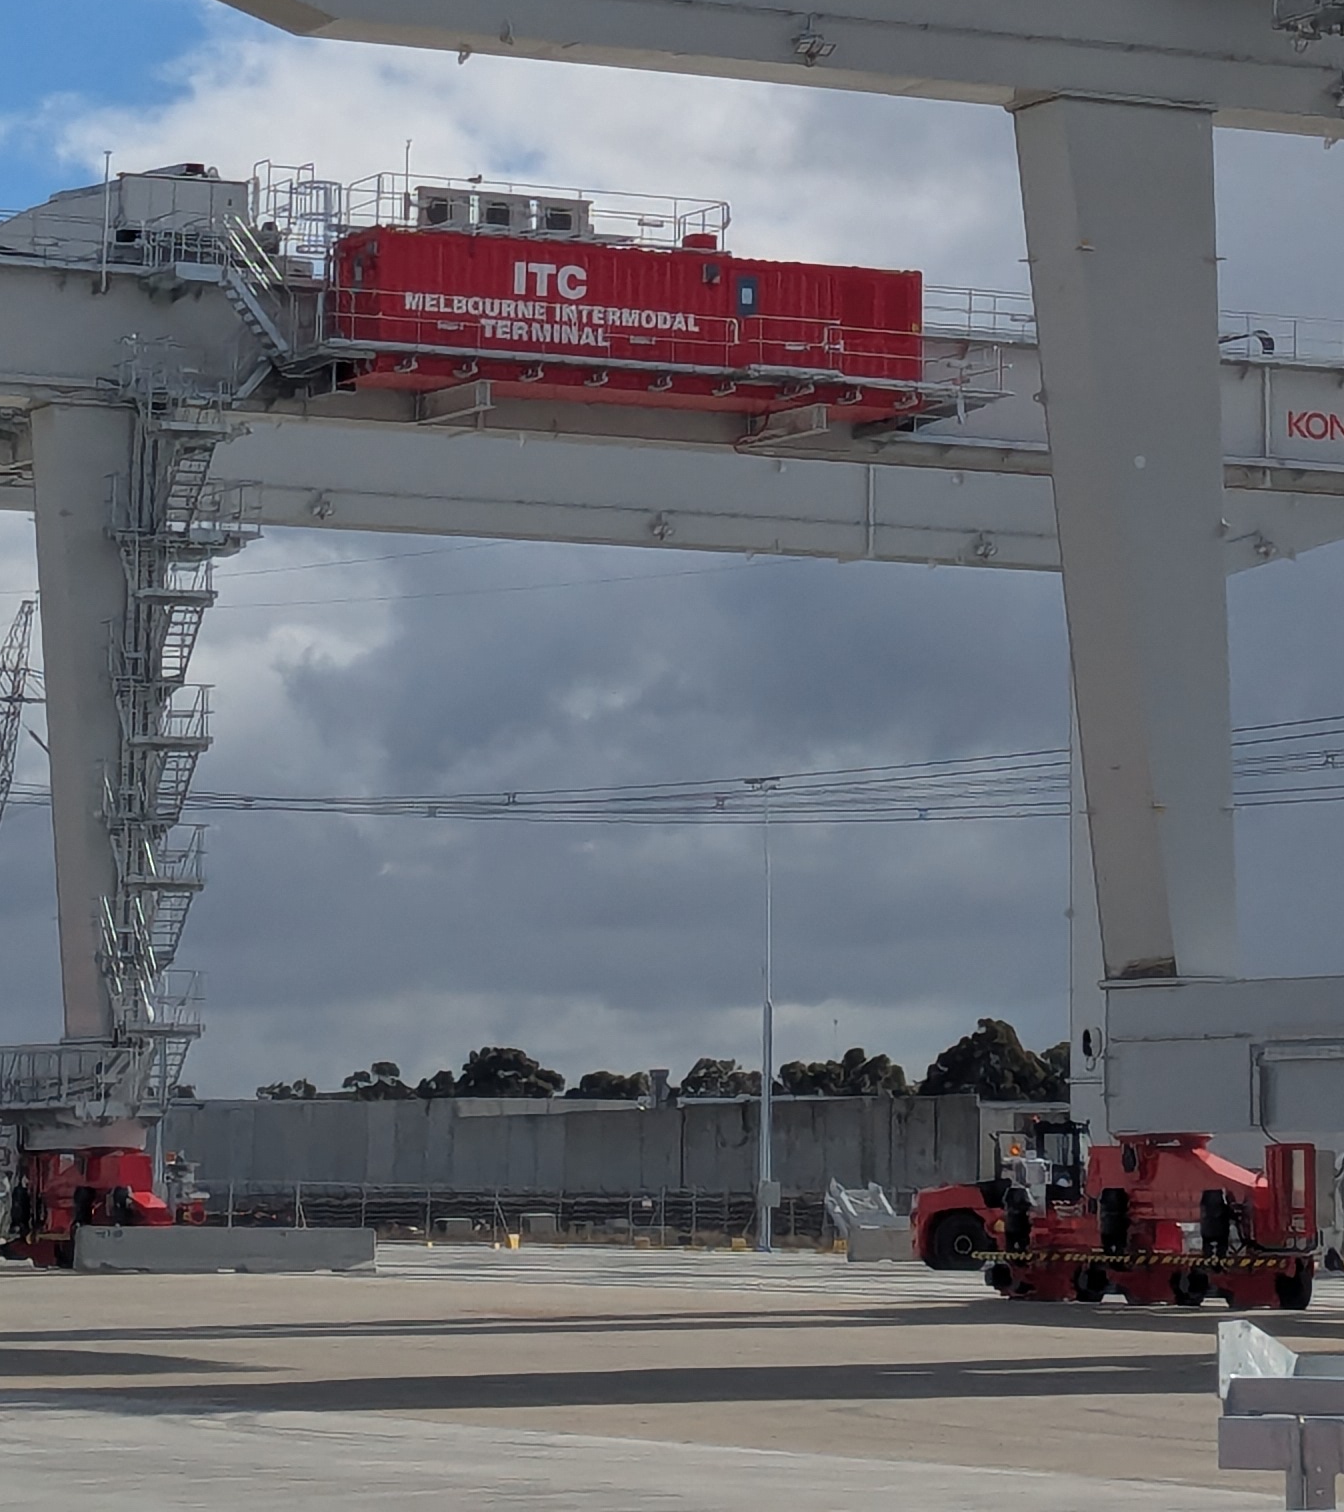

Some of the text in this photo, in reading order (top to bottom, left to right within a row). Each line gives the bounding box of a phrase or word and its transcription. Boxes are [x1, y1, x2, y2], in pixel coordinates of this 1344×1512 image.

[513, 261, 587, 300] ITC
[405, 292, 699, 332] MELBOURNE INTERMODAL
[480, 319, 610, 347] TERMINAL
